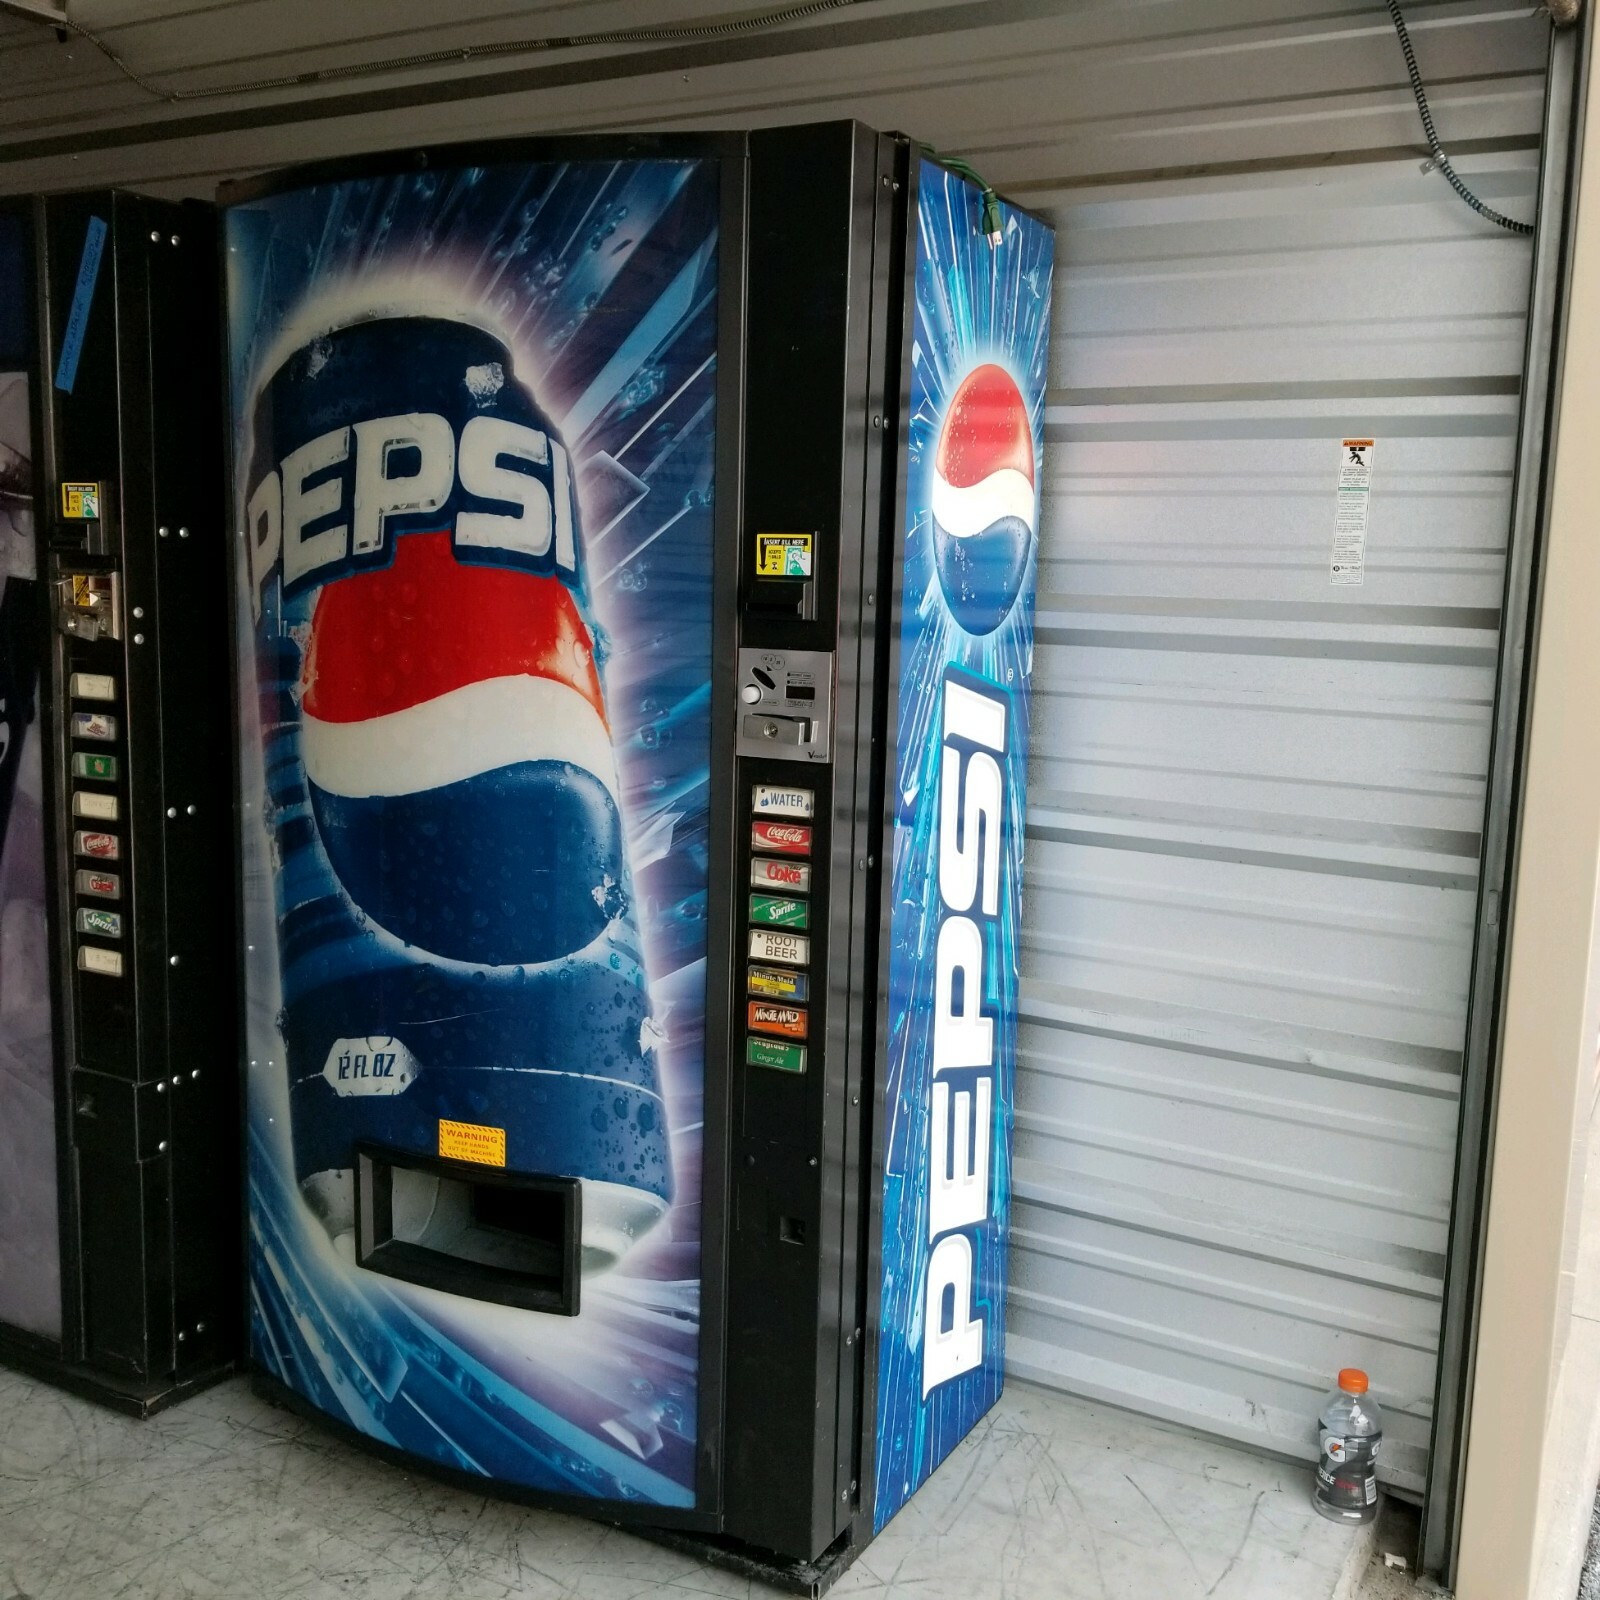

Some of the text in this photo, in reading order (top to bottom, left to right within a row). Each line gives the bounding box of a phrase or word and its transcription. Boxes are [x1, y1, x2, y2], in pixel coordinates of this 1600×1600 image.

[247, 412, 576, 626] PEPSI
[770, 792, 803, 808] WATER
[766, 861, 802, 884] Coke
[768, 902, 797, 920] Sprite
[87, 913, 117, 935] Sprite
[765, 935, 797, 948] ROOT
[765, 945, 798, 960] BEER
[923, 680, 1006, 1401] PEPSI
[353, 1054, 370, 1079] FL
[372, 1053, 397, 1078] OZ
[756, 1053, 785, 1066] Ginger Ale
[446, 1129, 498, 1144] WARNING
[469, 1142, 489, 1150] HANDS
[470, 1149, 496, 1158] MACHINE
[1324, 1436, 1346, 1463] G
